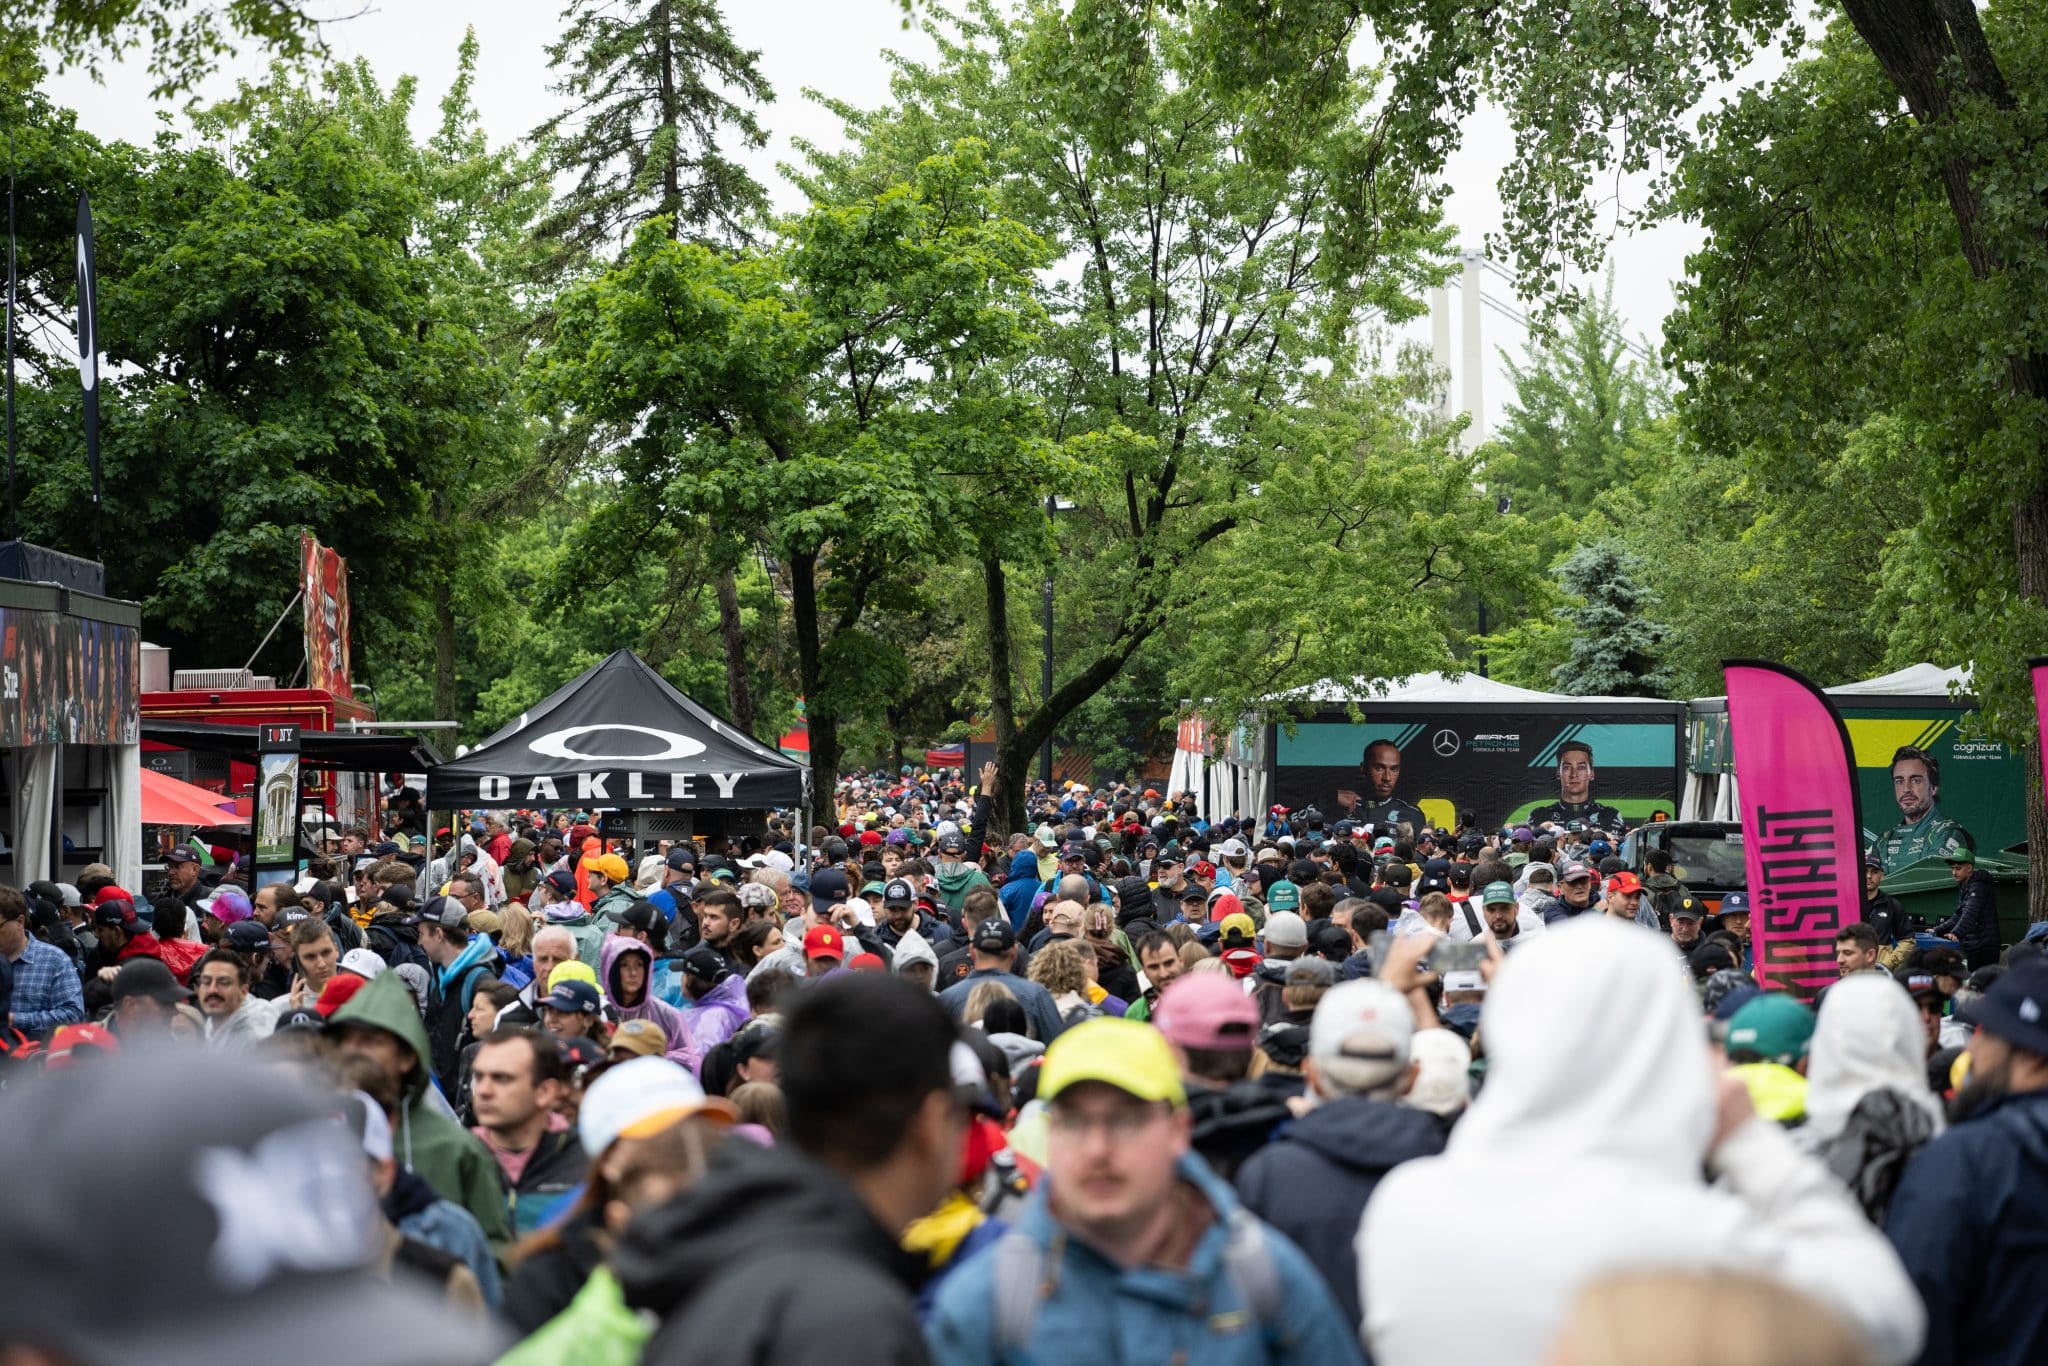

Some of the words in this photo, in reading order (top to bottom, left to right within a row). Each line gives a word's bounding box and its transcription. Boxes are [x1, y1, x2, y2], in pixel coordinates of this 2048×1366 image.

[268, 728, 273, 742] I
[279, 728, 294, 742] NY
[1953, 742, 2002, 754] cognizant
[479, 772, 743, 800] OAKLEY
